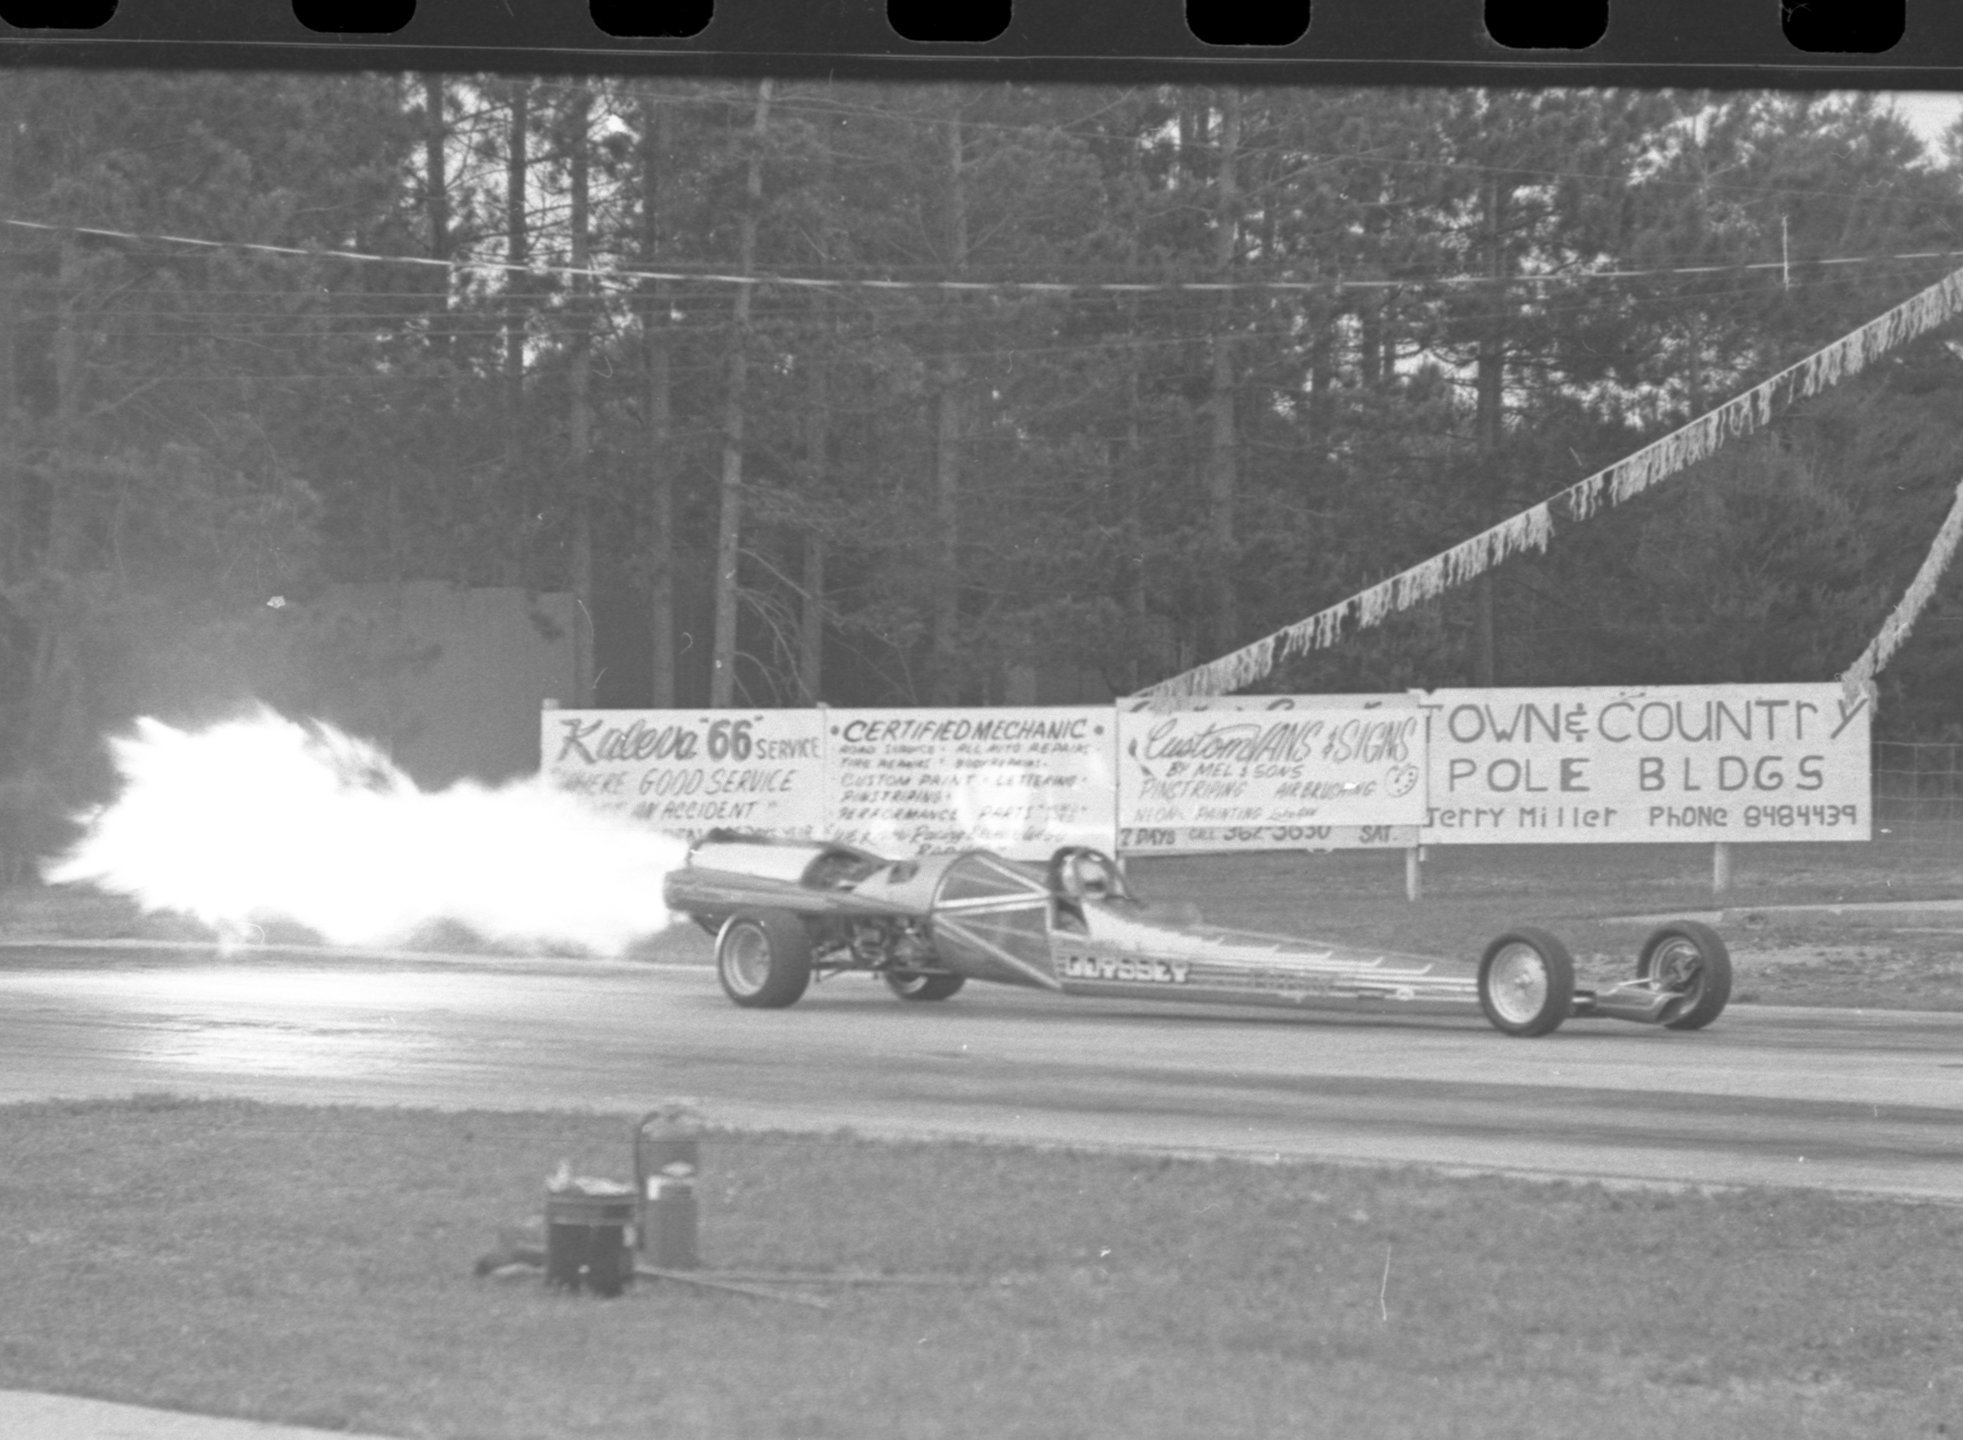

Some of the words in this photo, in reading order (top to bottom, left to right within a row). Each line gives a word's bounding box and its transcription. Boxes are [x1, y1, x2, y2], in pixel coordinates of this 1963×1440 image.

[843, 719, 971, 742] CERTIFIED
[970, 718, 1087, 740] MECHANIC
[1146, 717, 1262, 761] Custom
[1333, 717, 1417, 763] SIGNS
[755, 736, 820, 759] SERVICE
[1166, 761, 1191, 777] BY
[1193, 762, 1232, 777] MEL
[1254, 763, 1305, 778] SONS
[1449, 759, 1591, 792] POLE
[1639, 755, 1824, 791] BLDGS
[638, 768, 704, 796] GOOD
[704, 768, 799, 796] SERVICE
[660, 801, 760, 821] ACCIDENT
[1519, 806, 1617, 828] Miller
[1743, 805, 1857, 828] 8484439
